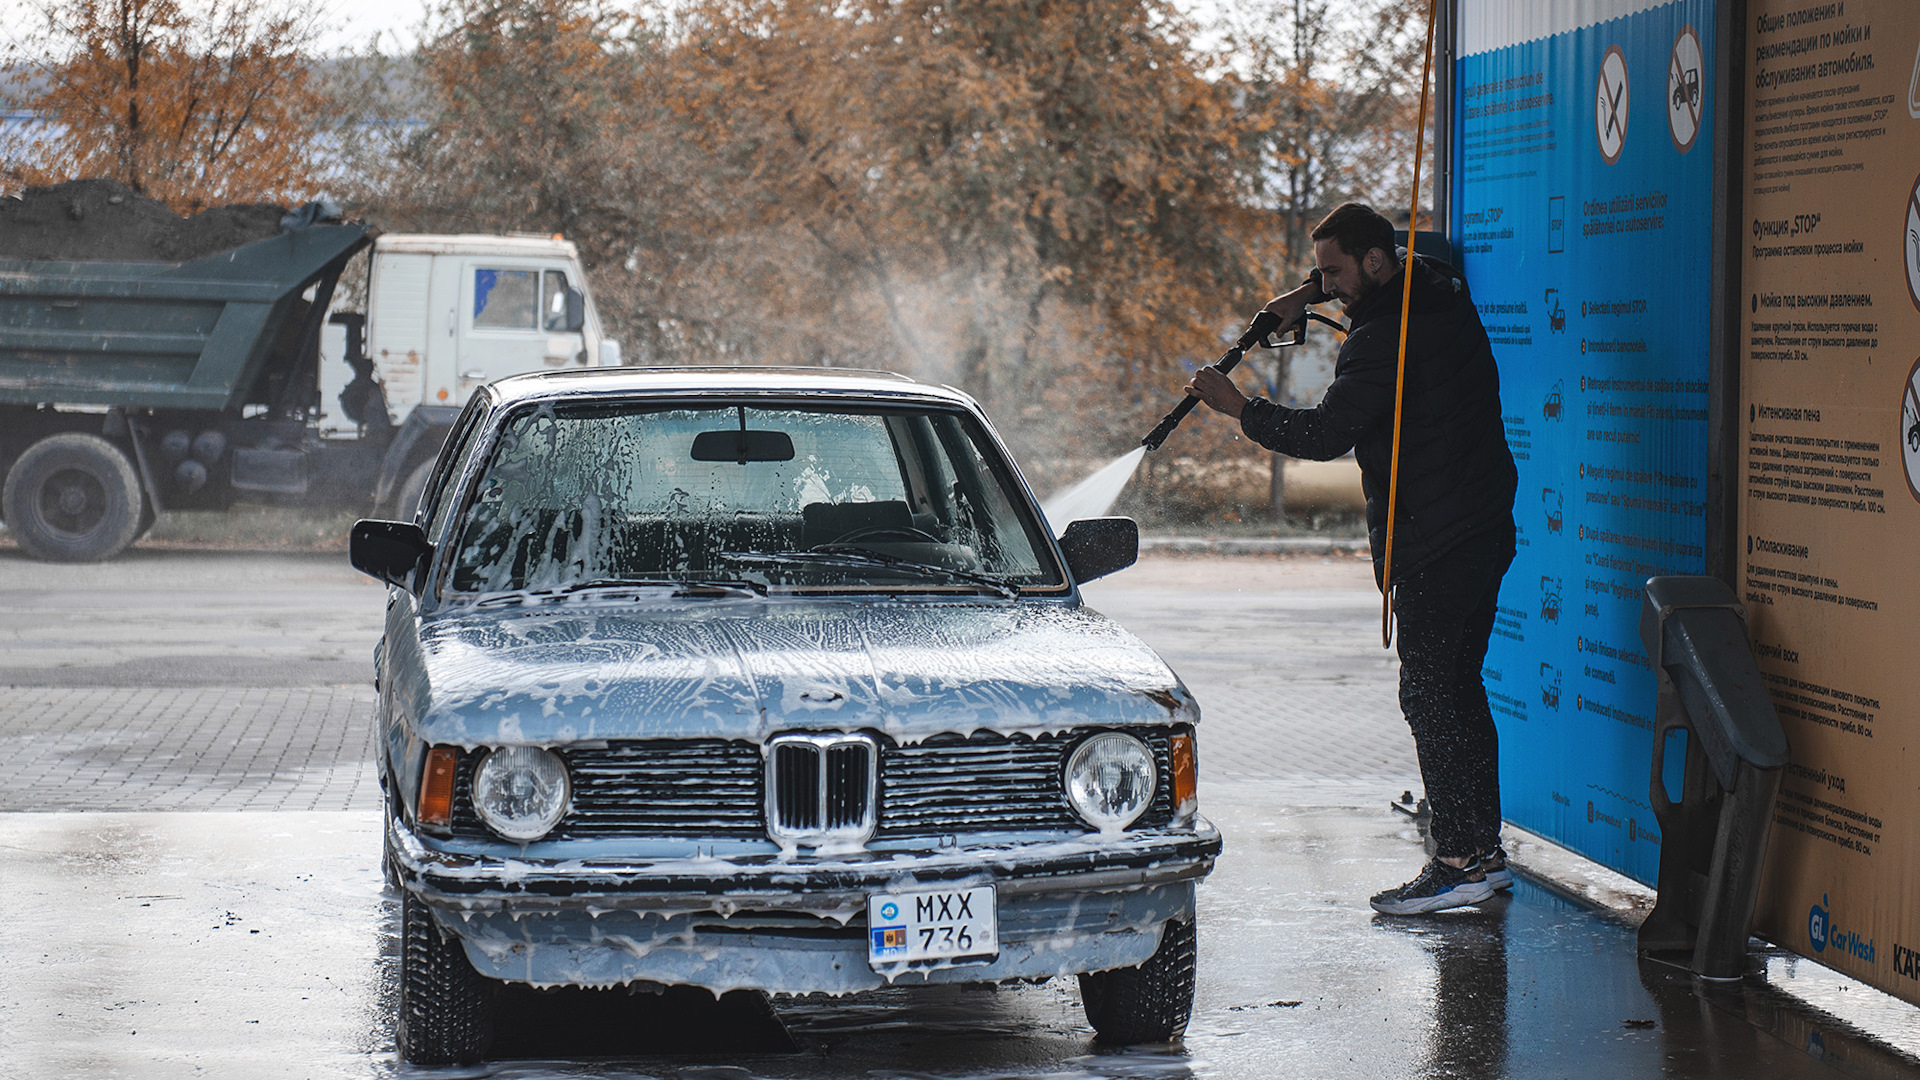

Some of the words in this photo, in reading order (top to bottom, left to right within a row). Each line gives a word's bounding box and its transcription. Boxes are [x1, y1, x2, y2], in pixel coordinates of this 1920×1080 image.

[1757, 13, 1784, 34] Общие
[1787, 4, 1836, 27] положения
[1838, 1, 1844, 16] и
[1756, 36, 1818, 66] рекомендации
[1820, 33, 1830, 49] по
[1833, 24, 1862, 45] мойки
[1864, 24, 1870, 40] и
[1756, 63, 1816, 90] обслуживания
[1818, 51, 1874, 80] автомобиля.
[1583, 199, 1608, 216] Ordinea
[1552, 219, 1562, 231] STOP
[1616, 220, 1624, 233] cu
[1753, 218, 1788, 240] Функция
[1783, 244, 1813, 256] остановки
[1814, 242, 1842, 257] процесса
[1844, 239, 1864, 254] мойки
[1760, 292, 1782, 308] Мойка
[1783, 294, 1796, 309] под
[1797, 294, 1828, 308] высоким
[1830, 294, 1872, 309] давлением.
[1758, 403, 1801, 422] Интенсивная
[1803, 408, 1820, 422] пена
[1756, 536, 1808, 558] Ополаскивание
[1783, 648, 1799, 664] воск
[1828, 774, 1846, 794] уход
[916, 892, 973, 923] MXX
[1812, 914, 1824, 942] GL
[919, 926, 972, 952] 736
